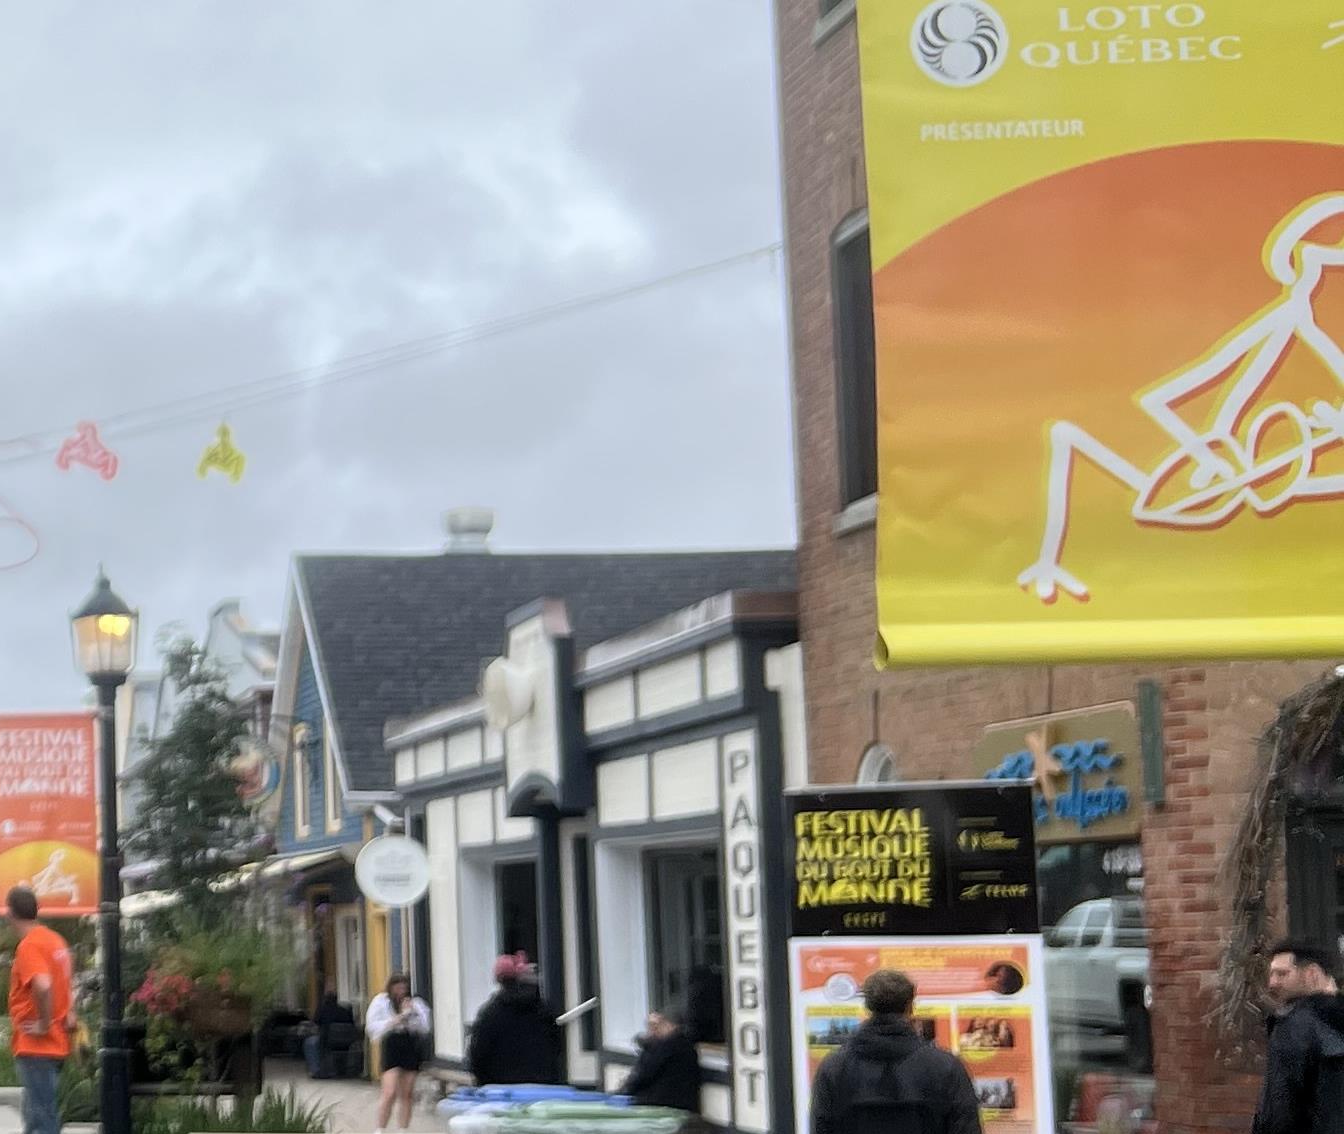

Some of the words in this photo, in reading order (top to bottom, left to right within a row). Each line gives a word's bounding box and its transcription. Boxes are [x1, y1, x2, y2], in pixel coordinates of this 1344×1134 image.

[1058, 4, 1206, 32] LOTO
[1019, 35, 1243, 68] QUÉBEC
[919, 119, 1085, 142] PRÉSENTATEUR
[794, 808, 931, 836] FESTIVAL
[796, 833, 931, 861] MUSIQUE
[796, 860, 828, 881] DU
[834, 858, 893, 880] BOUT
[897, 857, 930, 878] DU
[727, 749, 764, 1106] PAQUEBOT
